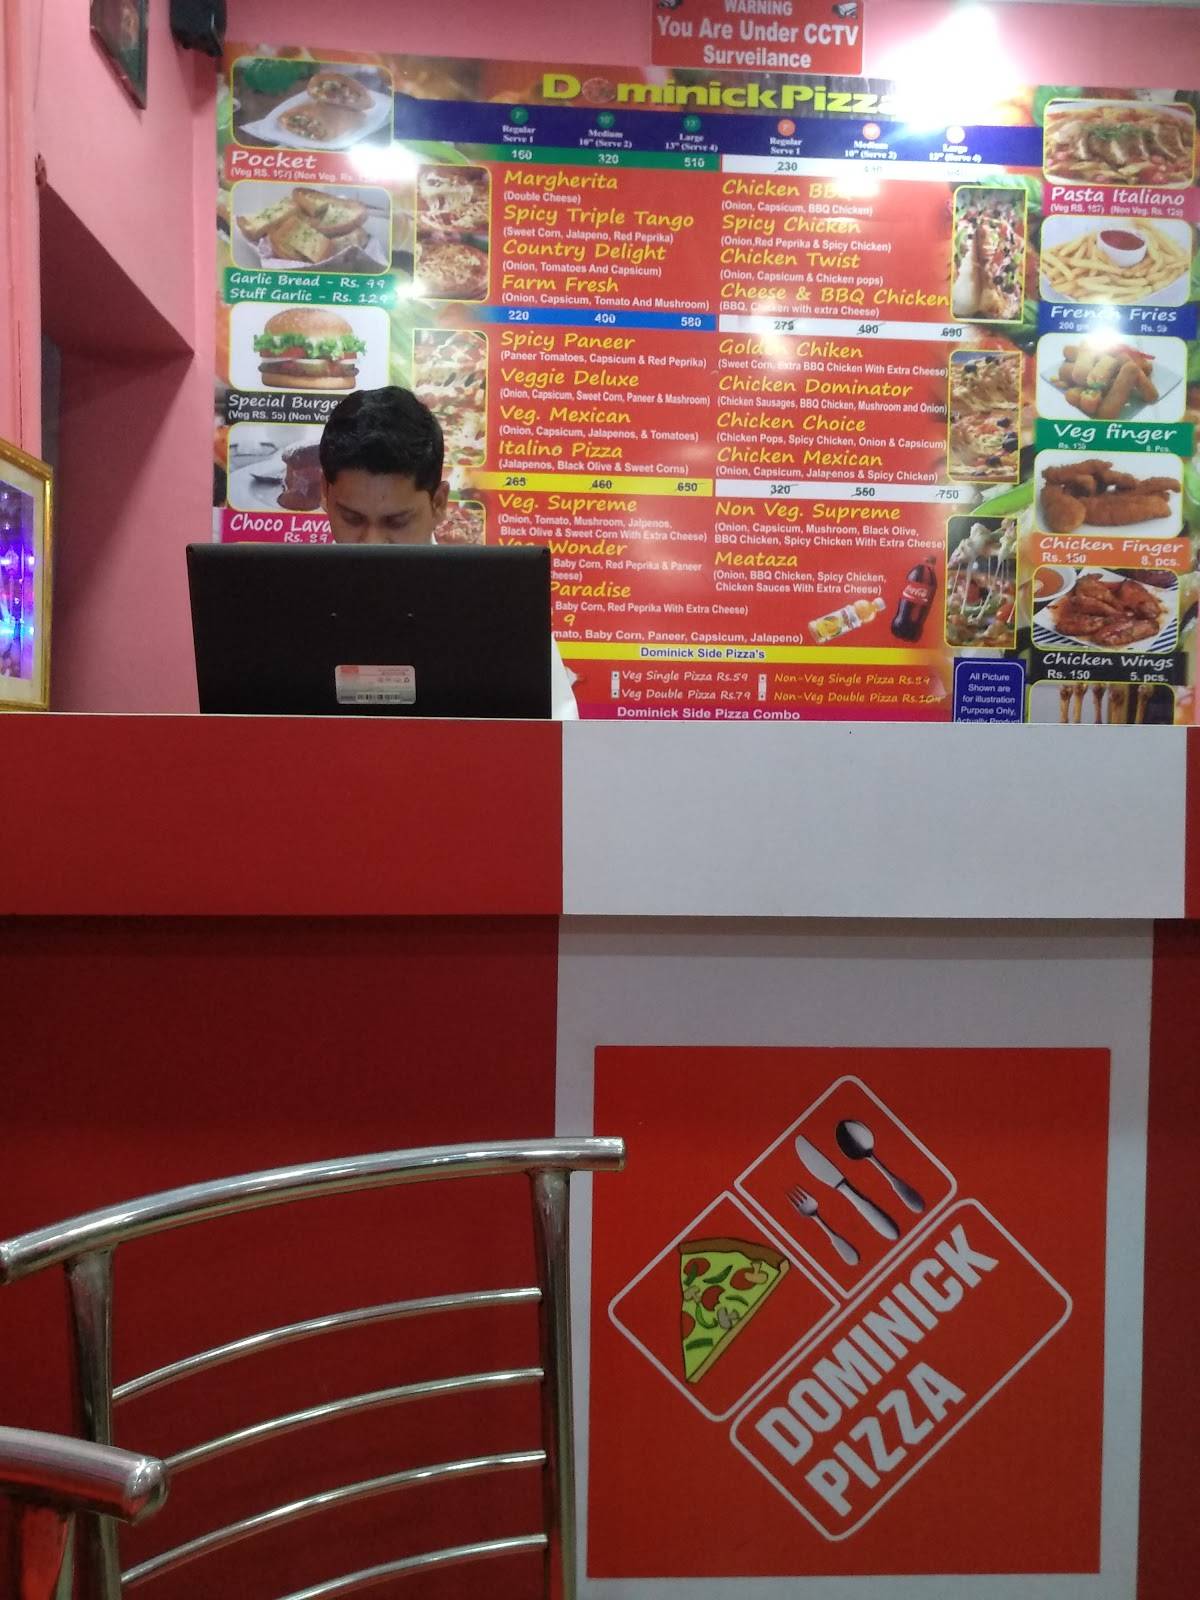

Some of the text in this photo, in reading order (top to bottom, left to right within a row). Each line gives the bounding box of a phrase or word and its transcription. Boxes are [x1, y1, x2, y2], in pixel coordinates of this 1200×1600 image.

[725, 0, 793, 17] WARNING
[657, 15, 858, 46] You Are Under CCTV
[703, 45, 811, 68] Surveilance
[502, 125, 536, 135] Regular
[232, 151, 317, 169] Pocket
[512, 150, 532, 160] 160
[599, 154, 619, 164] 320
[777, 162, 797, 171] 230
[504, 170, 618, 191] Margherita
[723, 179, 799, 197] Chicken
[1052, 187, 1185, 205] Pasta Italiano
[722, 201, 873, 216] (Onion, Capsicum, BBQ Chicken)
[504, 205, 694, 231] Spicy Triple Tango
[722, 214, 861, 235] Spicy Chicken
[503, 239, 666, 264] Country Delight
[721, 248, 861, 268] Chicken Twist
[230, 273, 271, 285] Garlic
[278, 275, 319, 287] Bread
[341, 278, 359, 288] Rs.
[502, 275, 618, 293] Farm Fresh
[720, 269, 883, 287] (Onion, Capsicum & Chicken pops)
[502, 293, 709, 311] (Onion, Capsicum, Tomato And Mushroom)
[721, 283, 949, 306] Cheese & BBQ Chicken
[509, 311, 529, 320] 220
[681, 317, 701, 327] 580
[1130, 308, 1177, 322] Fries
[501, 331, 635, 350] Spicy Paneer
[797, 342, 863, 358] Chiken
[501, 368, 639, 389] Veggie Deluxe
[719, 375, 912, 397] Chicken Dominator
[229, 395, 342, 412] Special Burge
[717, 396, 947, 414] (Chicken Sausages, BBQ Chicken, Mushroom and Onion)
[501, 406, 630, 425] Veg. Mexican
[717, 412, 866, 432] Chicken Choice
[500, 425, 698, 442] (Onion, Capsicum, Jalapenos, & Tomatoes)
[717, 433, 946, 451] (Chicken Pops, Spicy Chicken, Onion & Capsicum)
[1054, 423, 1177, 444] Veg finger
[499, 441, 622, 458] Italino Pizza
[717, 447, 883, 467] Chicken Mexican
[505, 477, 526, 487] 265
[716, 467, 751, 477] (Onion,
[753, 468, 804, 479] Capsicum,
[858, 470, 864, 479] &
[868, 470, 893, 481] Spicy
[896, 471, 938, 483] Chicken)
[592, 480, 612, 489] 460
[677, 483, 697, 492] 650
[939, 490, 959, 499] 750
[499, 494, 637, 515] Veg. Supreme
[716, 501, 901, 522] Non Veg. Supreme
[230, 514, 282, 532] Choco
[715, 522, 919, 536] (Onion, Capsicum, Mushroom, Black Olive,
[715, 534, 945, 550] BBQ Chicken, Spicy Chicken With Extra Cheese)
[1040, 537, 1184, 557] Chicken Finger
[715, 551, 798, 567] Meataza
[716, 582, 881, 595] Chicken Sauces With Extra Cheese)
[641, 647, 764, 659] Dominick Side Pizza's
[1043, 653, 1174, 670] Chicken Wings
[970, 672, 1009, 681] All Picture
[1048, 670, 1066, 679] Rs.
[1070, 670, 1090, 680] 150
[1144, 673, 1168, 683] pcs.
[968, 684, 996, 692] Shown
[963, 695, 1015, 704] for illustration
[618, 707, 800, 720] Dominick Side Pizza Combo
[961, 706, 994, 716] Purpose
[755, 1224, 999, 1466] DOMINICK
[805, 1362, 966, 1517] PIZZA
